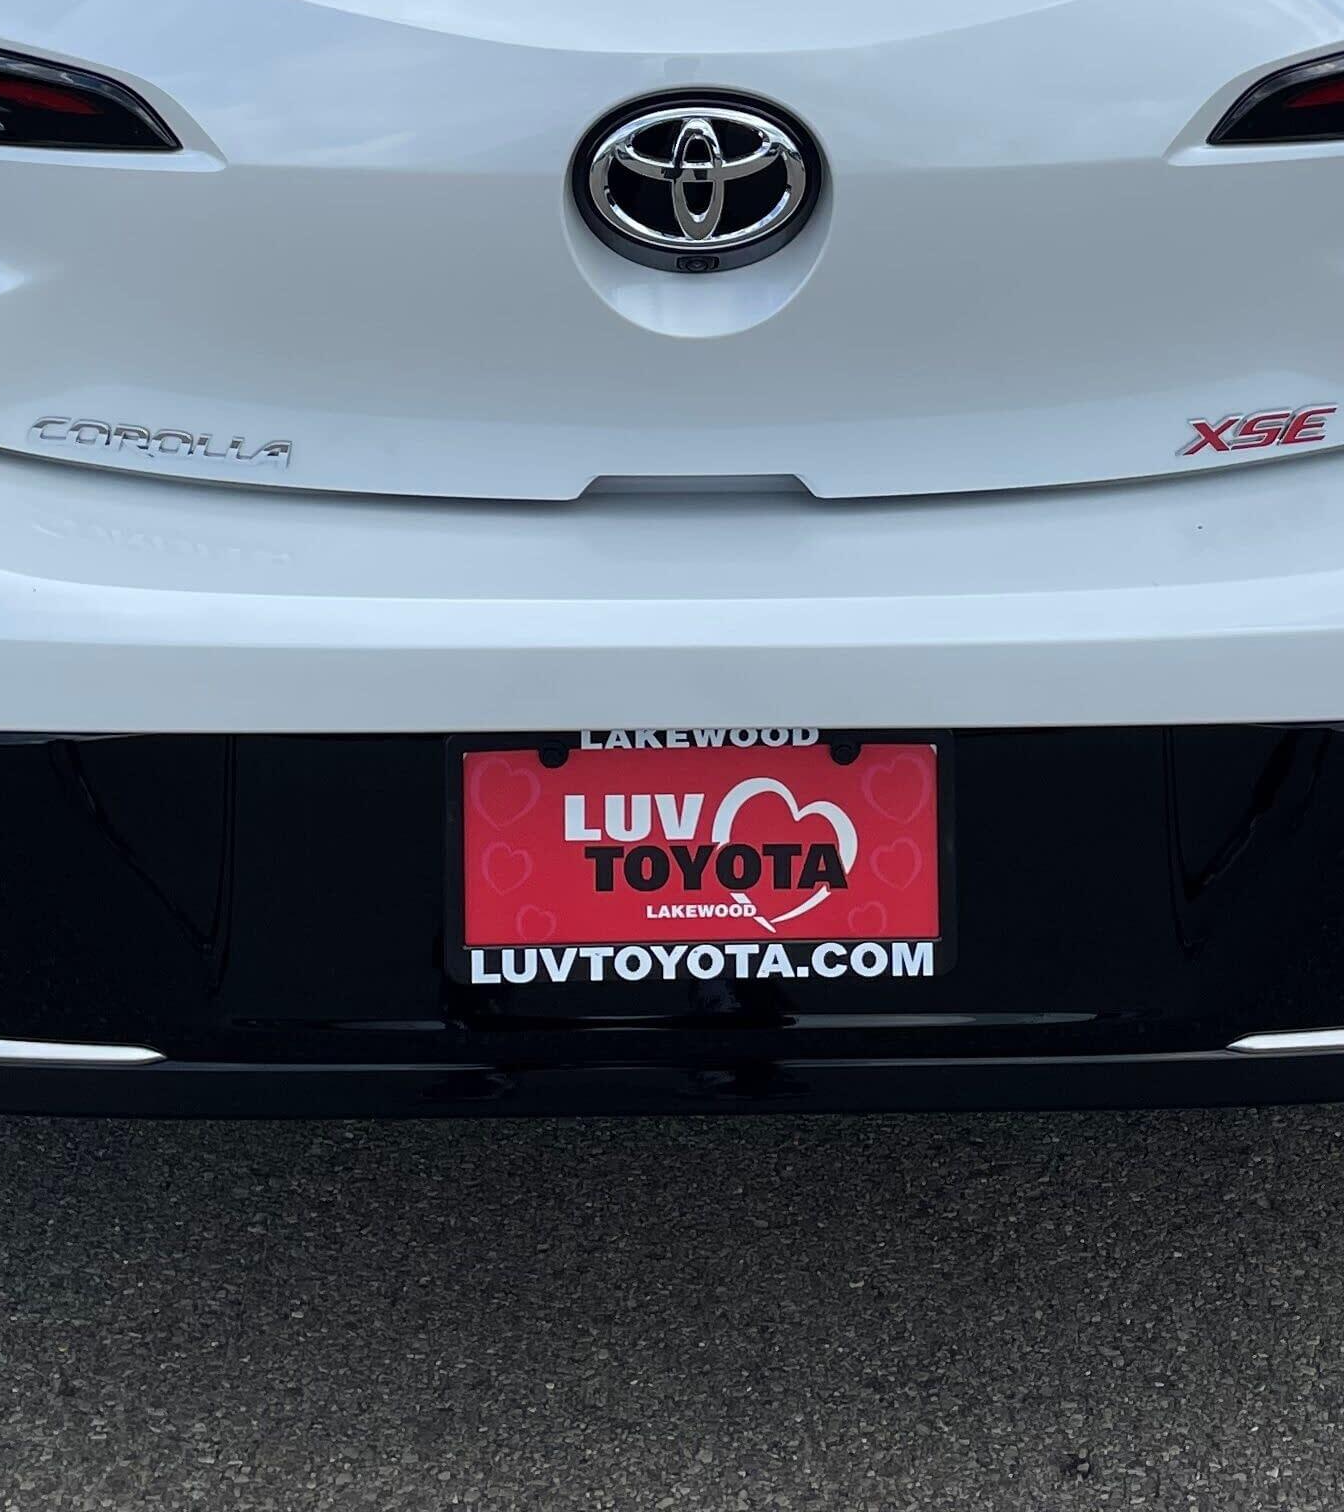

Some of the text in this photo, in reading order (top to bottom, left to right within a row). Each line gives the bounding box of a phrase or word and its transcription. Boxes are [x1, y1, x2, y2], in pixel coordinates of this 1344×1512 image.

[27, 415, 294, 470] COROLLA
[1176, 402, 1339, 456] XSE
[580, 727, 820, 751] LAKEWOOD
[564, 793, 705, 842] LUV
[584, 843, 849, 892] TOYOTA
[646, 903, 757, 919] LAKEWOOD
[469, 941, 935, 985] LUVTOYOTA.COM
